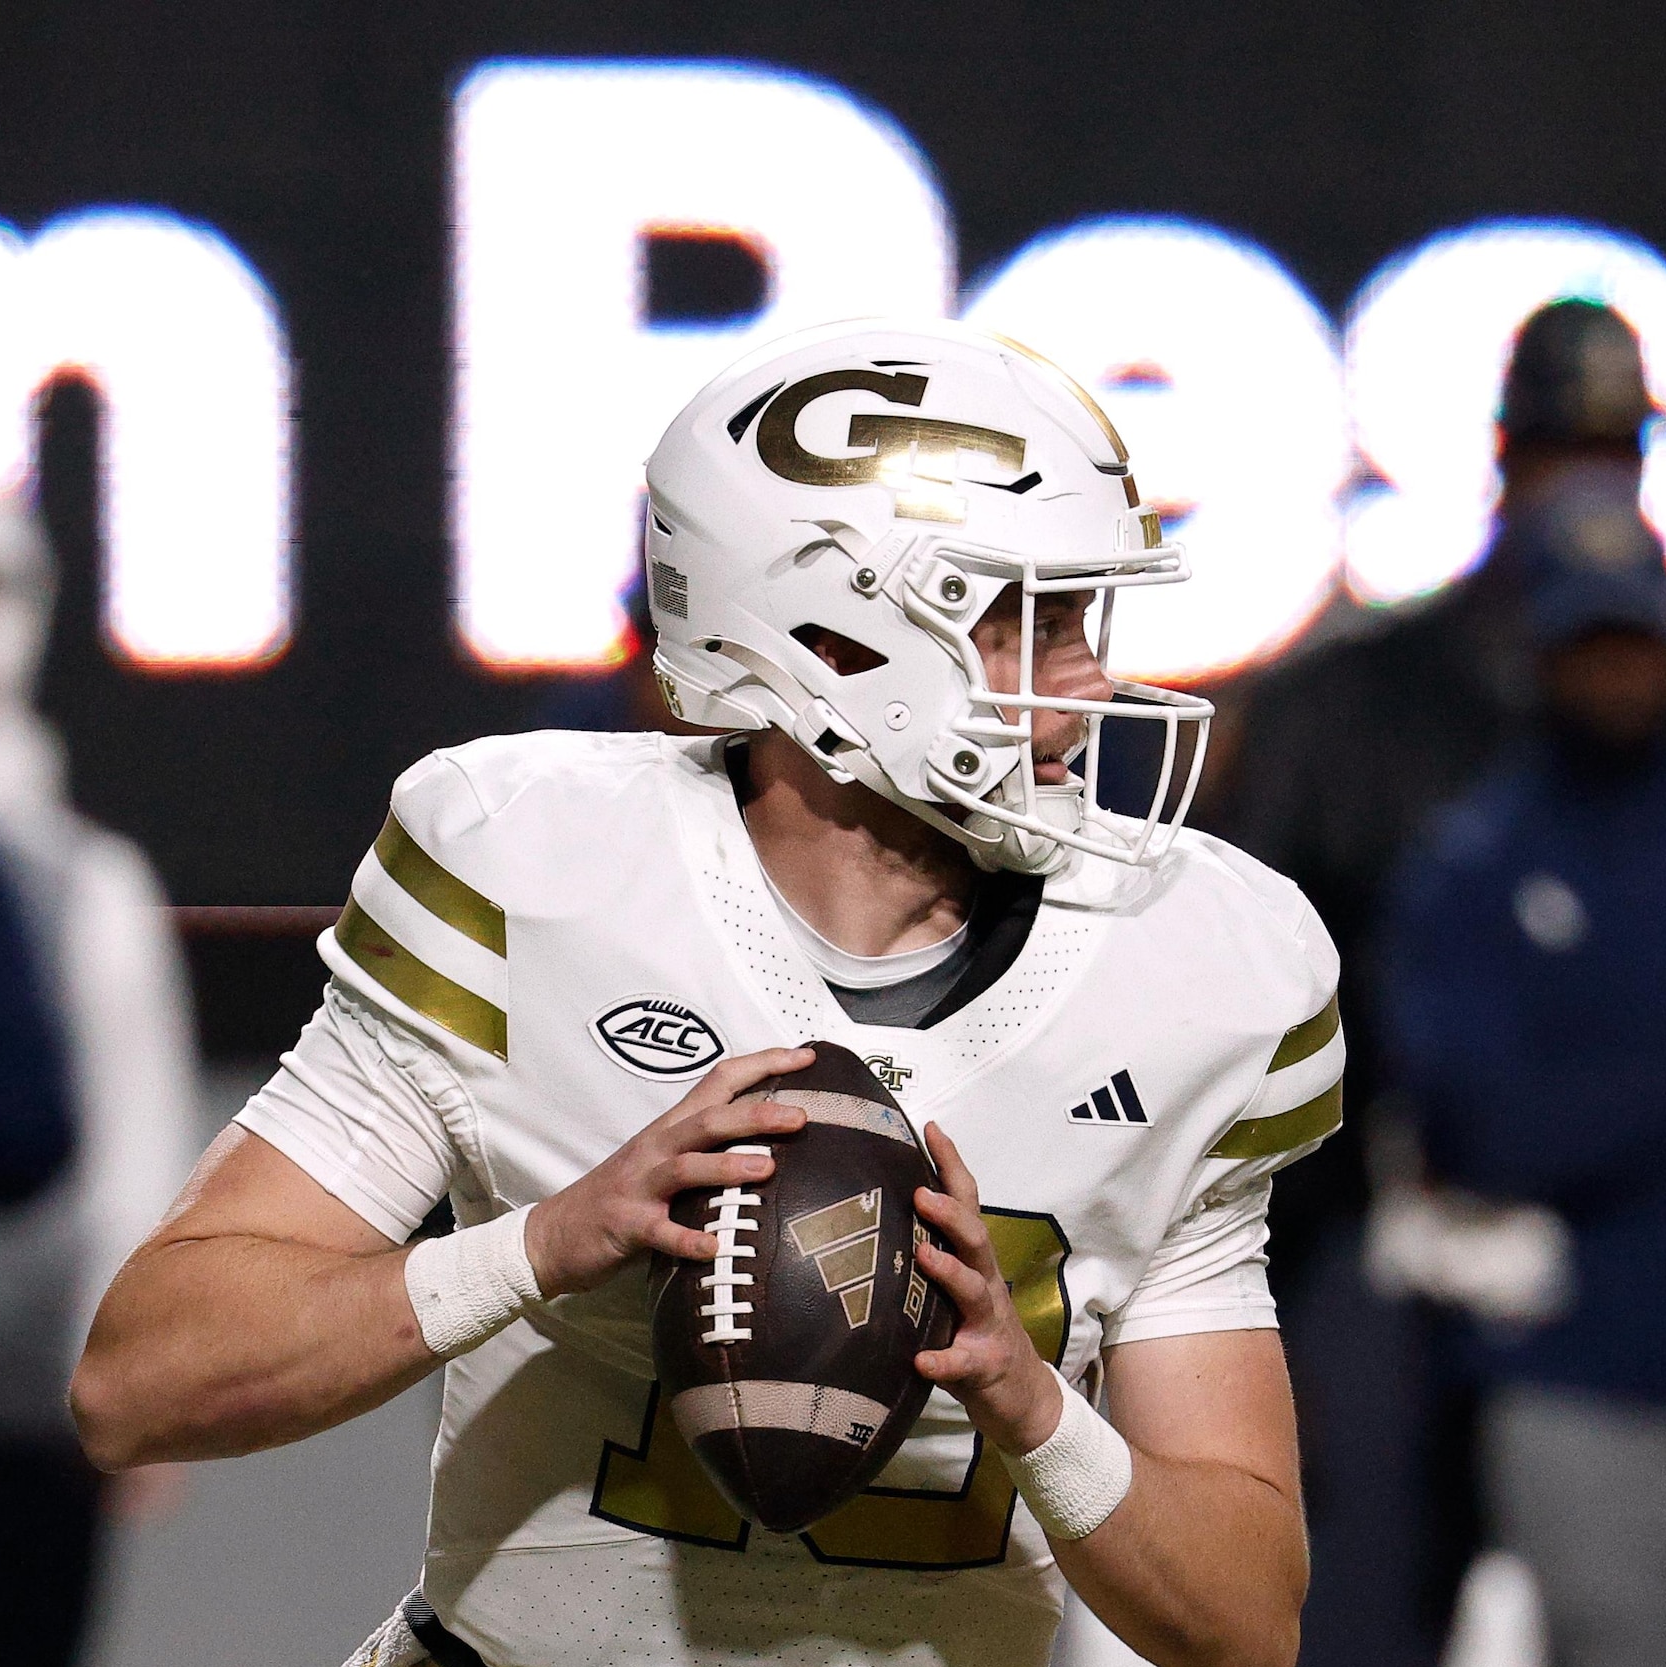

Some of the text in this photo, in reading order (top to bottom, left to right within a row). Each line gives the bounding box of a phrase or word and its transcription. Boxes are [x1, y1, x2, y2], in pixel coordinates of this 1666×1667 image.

[755, 368, 1027, 524] GT
[616, 1015, 706, 1052] ACC
[864, 1055, 912, 1092] GT
